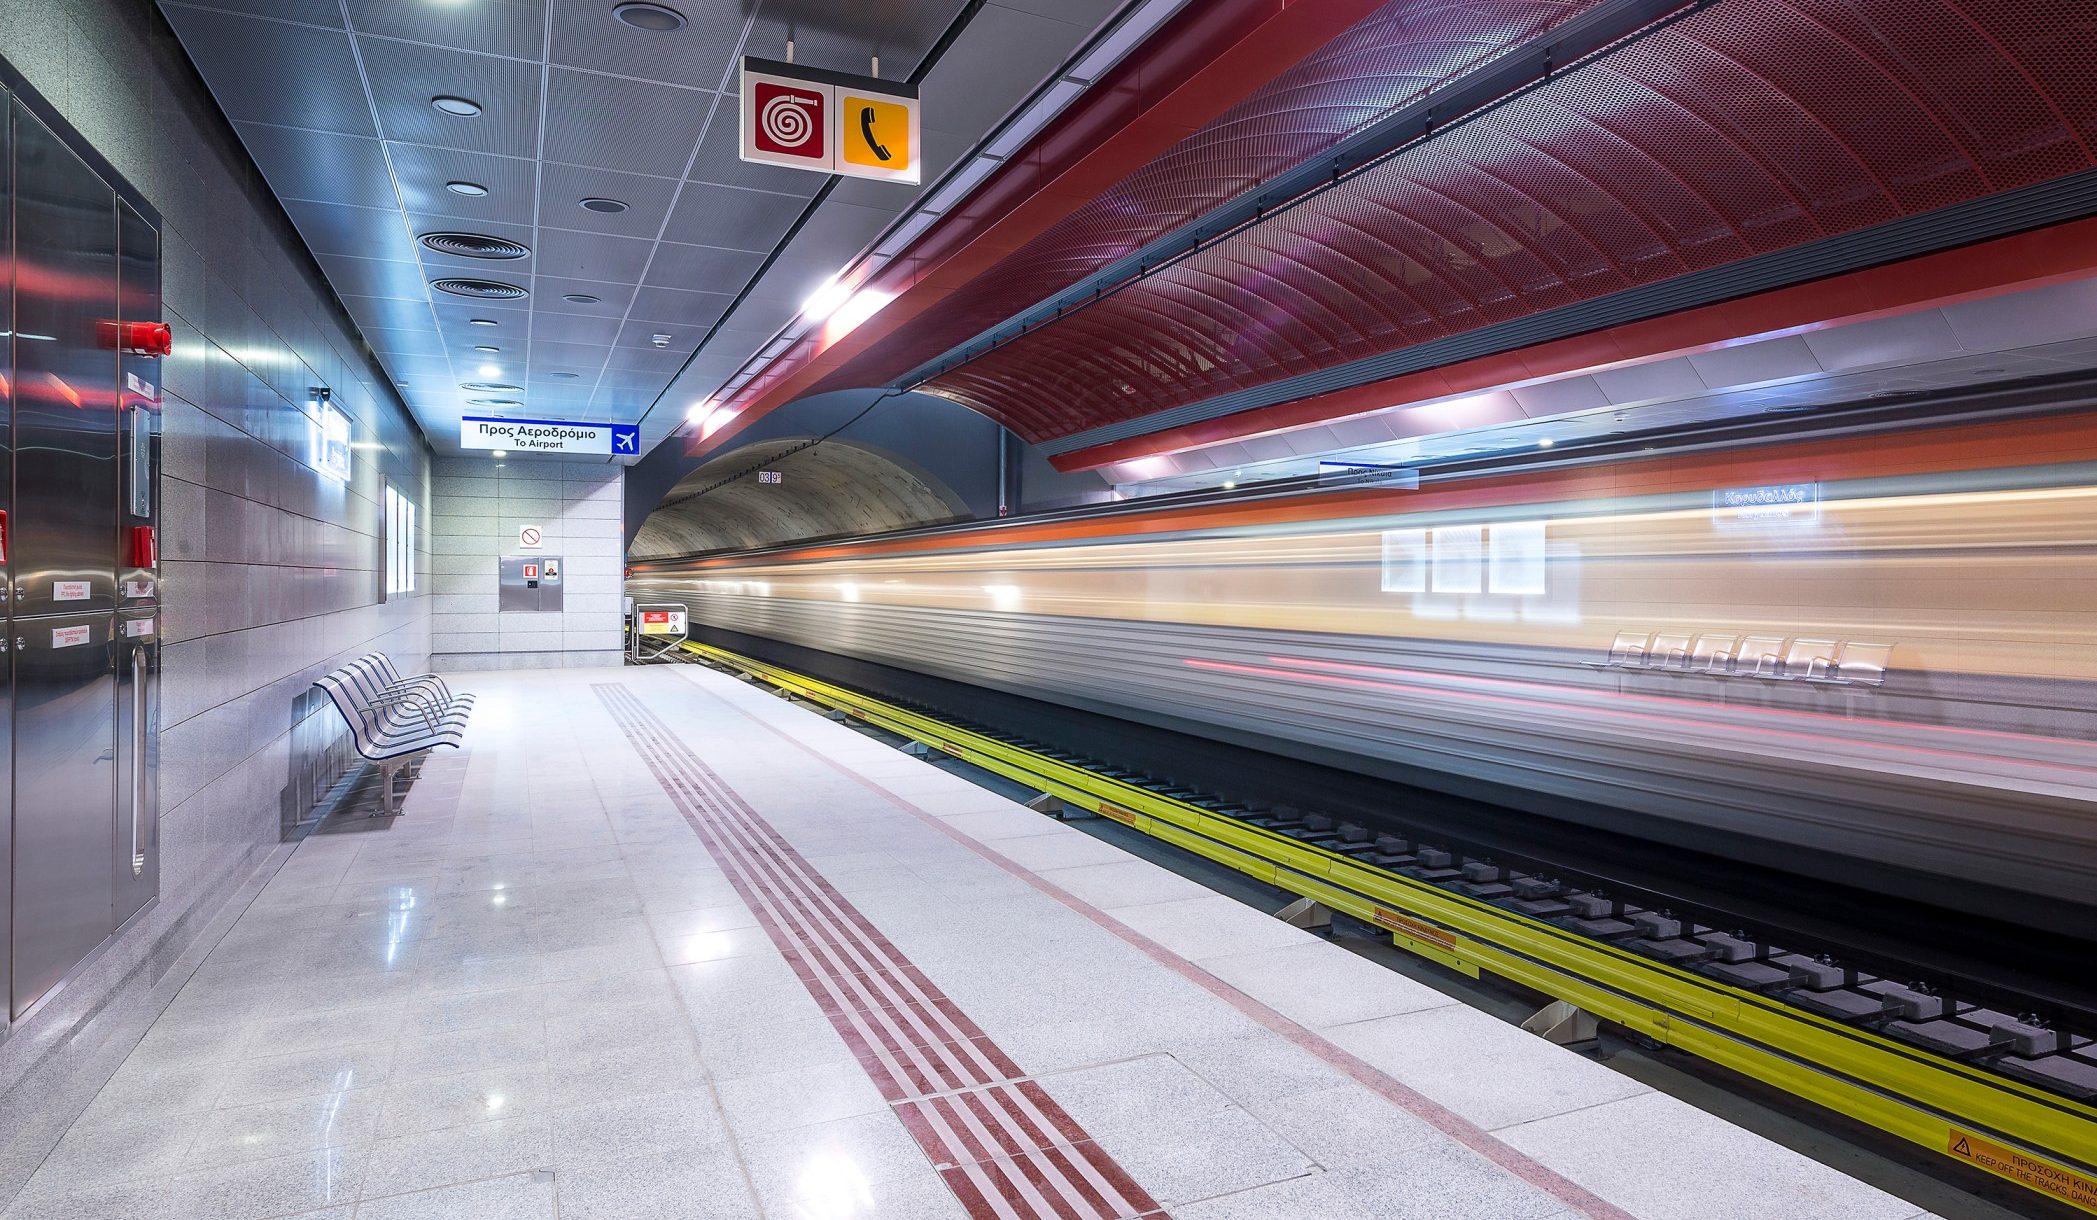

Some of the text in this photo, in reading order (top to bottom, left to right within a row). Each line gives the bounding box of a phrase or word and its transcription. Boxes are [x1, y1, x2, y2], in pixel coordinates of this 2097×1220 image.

[479, 424, 596, 440] Προς Αεροδρόμιο
[514, 439, 563, 449] To Airport
[1975, 1153, 1996, 1166] KEEP
[1998, 1161, 2014, 1173] OFF
[2016, 1169, 2032, 1181] THE
[2072, 1190, 2097, 1207] DANG
[2012, 1155, 2069, 1185] ΠΡΟΣΟΧΗ
